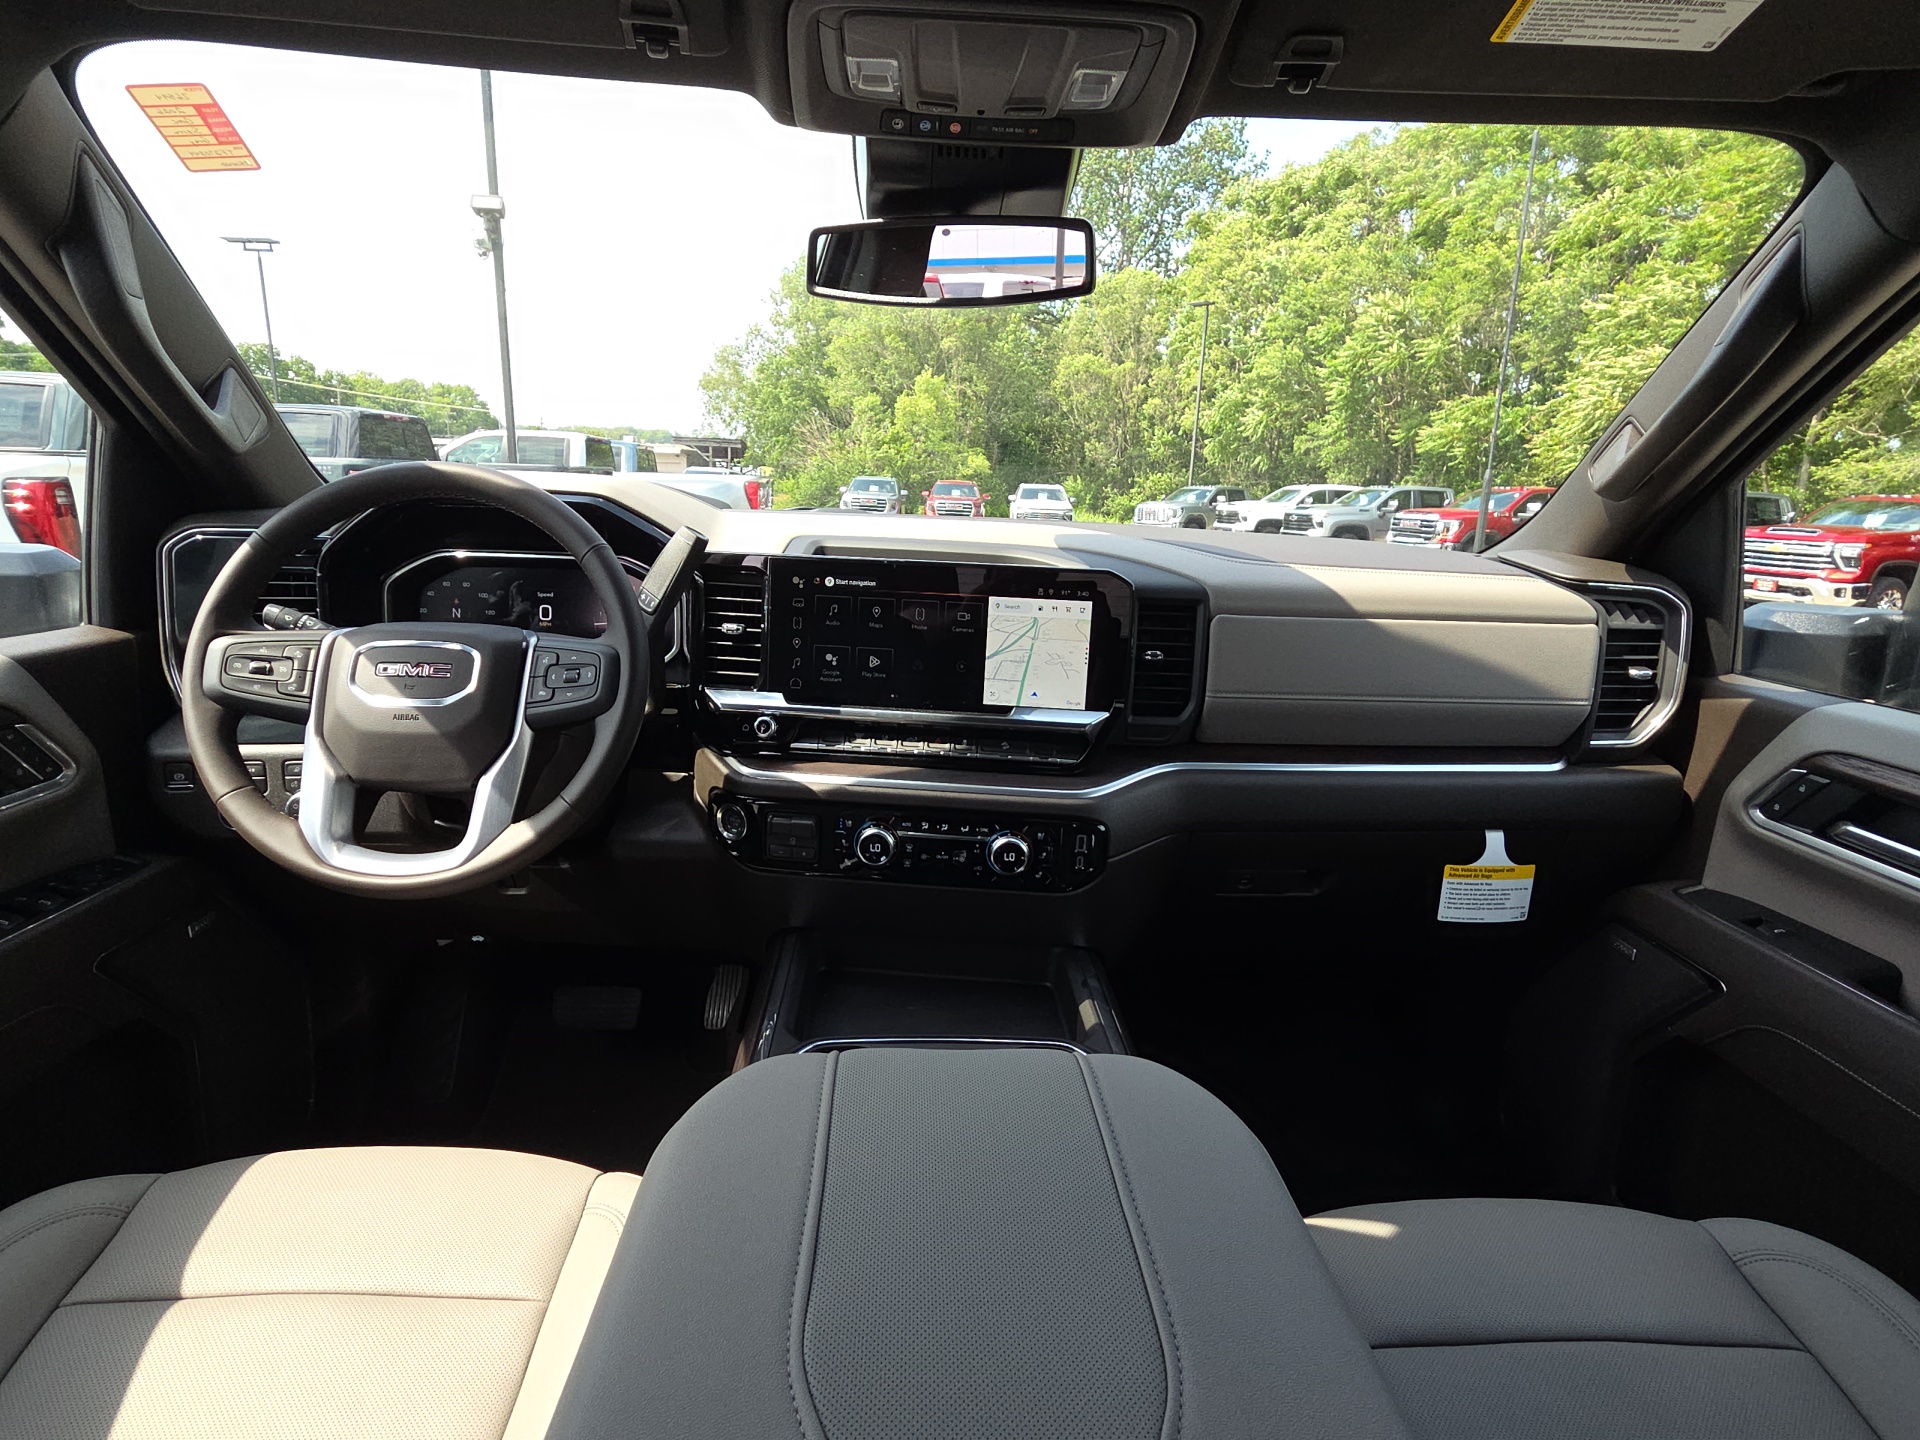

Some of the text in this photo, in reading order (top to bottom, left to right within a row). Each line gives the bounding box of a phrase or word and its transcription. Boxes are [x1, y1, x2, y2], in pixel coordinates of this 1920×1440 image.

[835, 578, 877, 588] Start navigation
[537, 591, 554, 599] Speed
[452, 608, 461, 619] N
[539, 604, 552, 621] 0
[868, 621, 884, 629] Maps
[375, 661, 454, 679] GMC
[822, 668, 840, 677] Google
[861, 671, 887, 679] Play Store
[392, 713, 420, 721] AIRBAG
[869, 843, 881, 853] LO
[1003, 852, 1016, 862] LO
